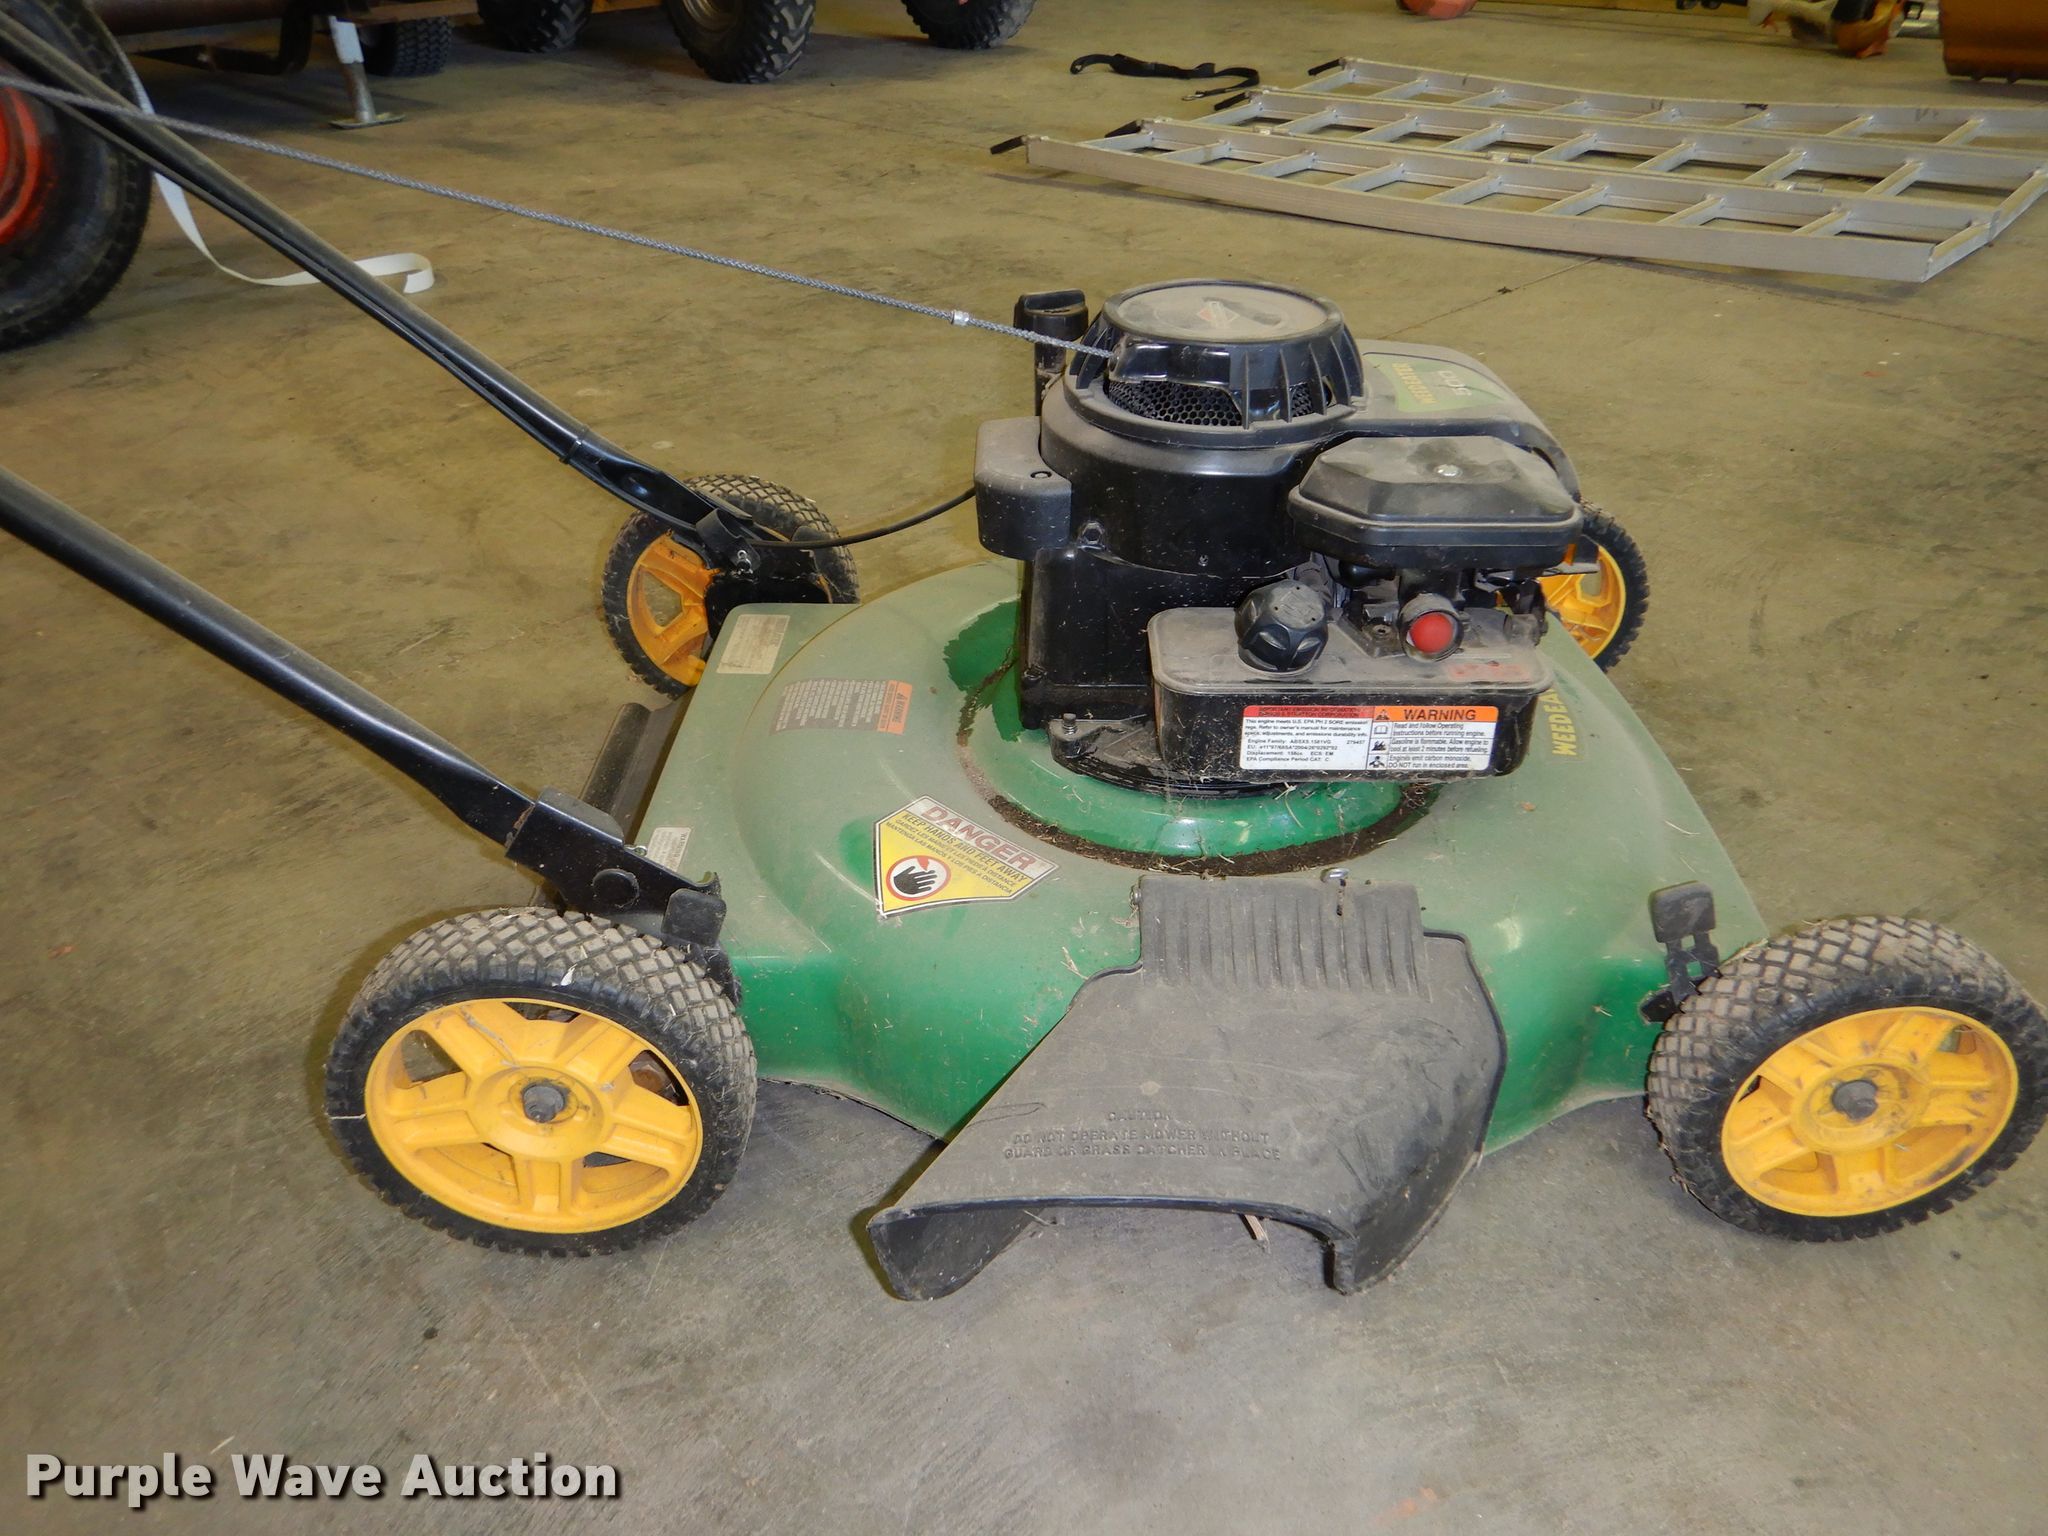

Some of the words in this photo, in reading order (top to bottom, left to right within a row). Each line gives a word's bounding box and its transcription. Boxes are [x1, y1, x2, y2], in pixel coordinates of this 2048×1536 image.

[1404, 709, 1476, 720] WARNING
[1538, 688, 1577, 756] WEEDEA
[921, 805, 1037, 871] DANGER
[902, 813, 927, 827] KEEP
[924, 825, 956, 844] HANDS
[954, 842, 976, 855] AND
[974, 852, 998, 867] FEET
[997, 866, 1028, 881] AWAY
[1107, 1110, 1171, 1122] CAUTION
[1039, 1130, 1065, 1143] NOT
[1071, 1129, 1137, 1142] OPERATE
[1143, 1129, 1196, 1141] MOWER
[1201, 1129, 1270, 1144] WITHOUT
[1004, 1146, 1052, 1159] GUARD
[1058, 1145, 1076, 1156] OR
[1082, 1144, 1130, 1156] GRASS
[1137, 1144, 1205, 1156] CATCHER
[1234, 1146, 1280, 1161] PLACE
